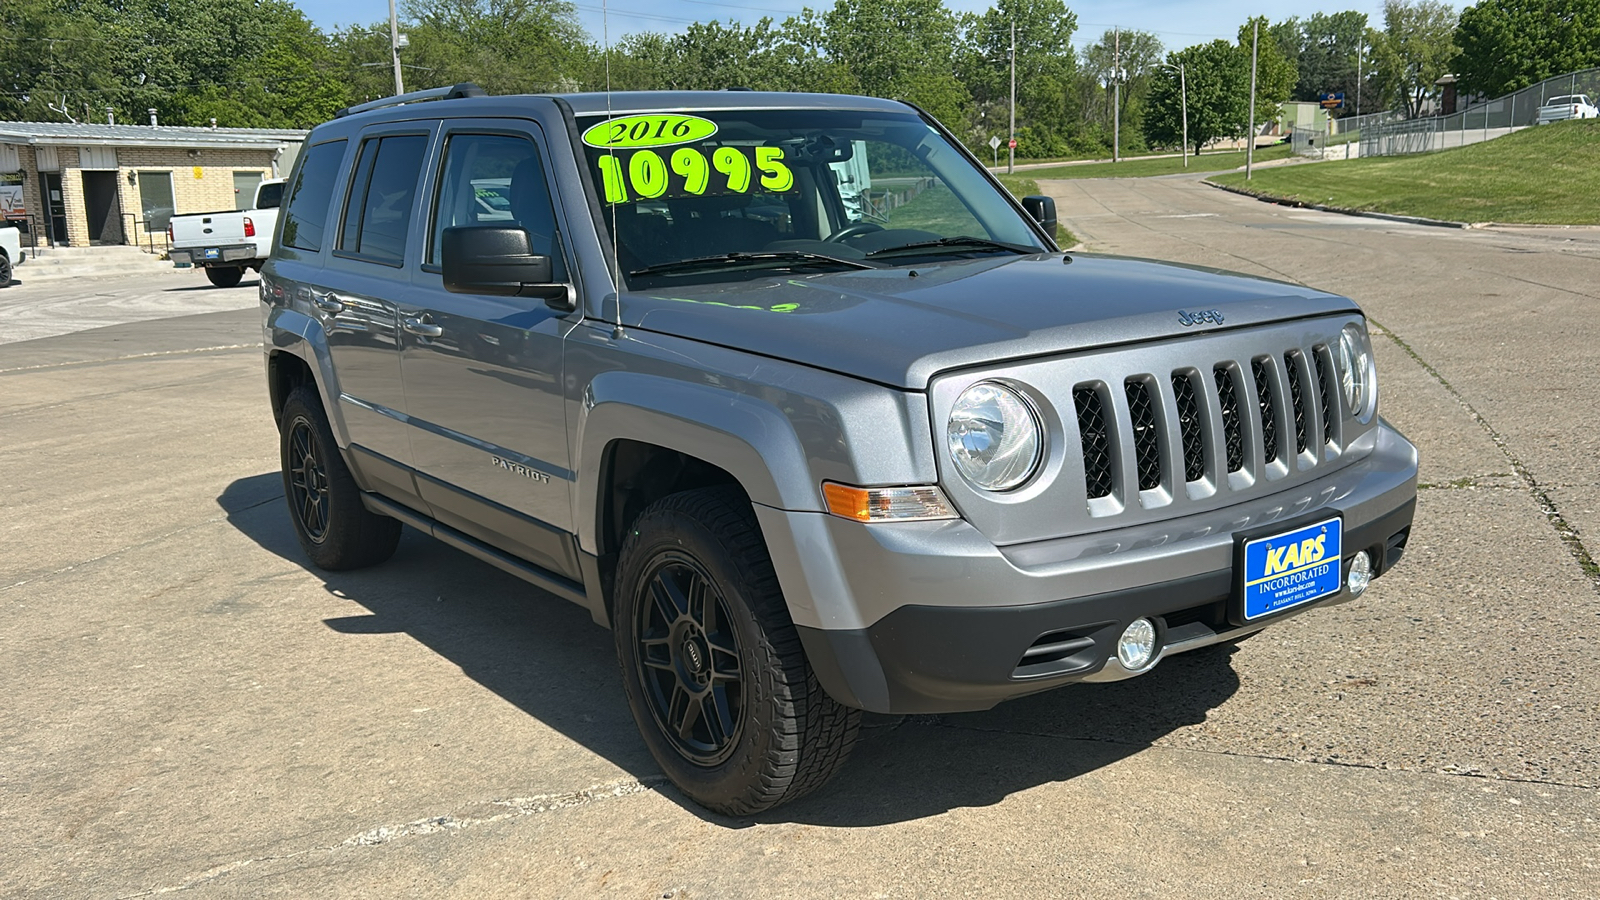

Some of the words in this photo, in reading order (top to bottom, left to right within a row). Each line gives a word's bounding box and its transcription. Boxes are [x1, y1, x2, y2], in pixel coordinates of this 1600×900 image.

[605, 118, 694, 144] 2016
[598, 146, 794, 204] 10995
[1178, 309, 1225, 326] Jeep
[491, 456, 550, 484] PATRIOT
[1264, 533, 1326, 576] KARS
[1259, 564, 1329, 594] INCORPORATED
[1274, 581, 1316, 598] www.kars-inc.com
[1273, 595, 1294, 606] PLEASANT
[1294, 592, 1305, 600] HILL
